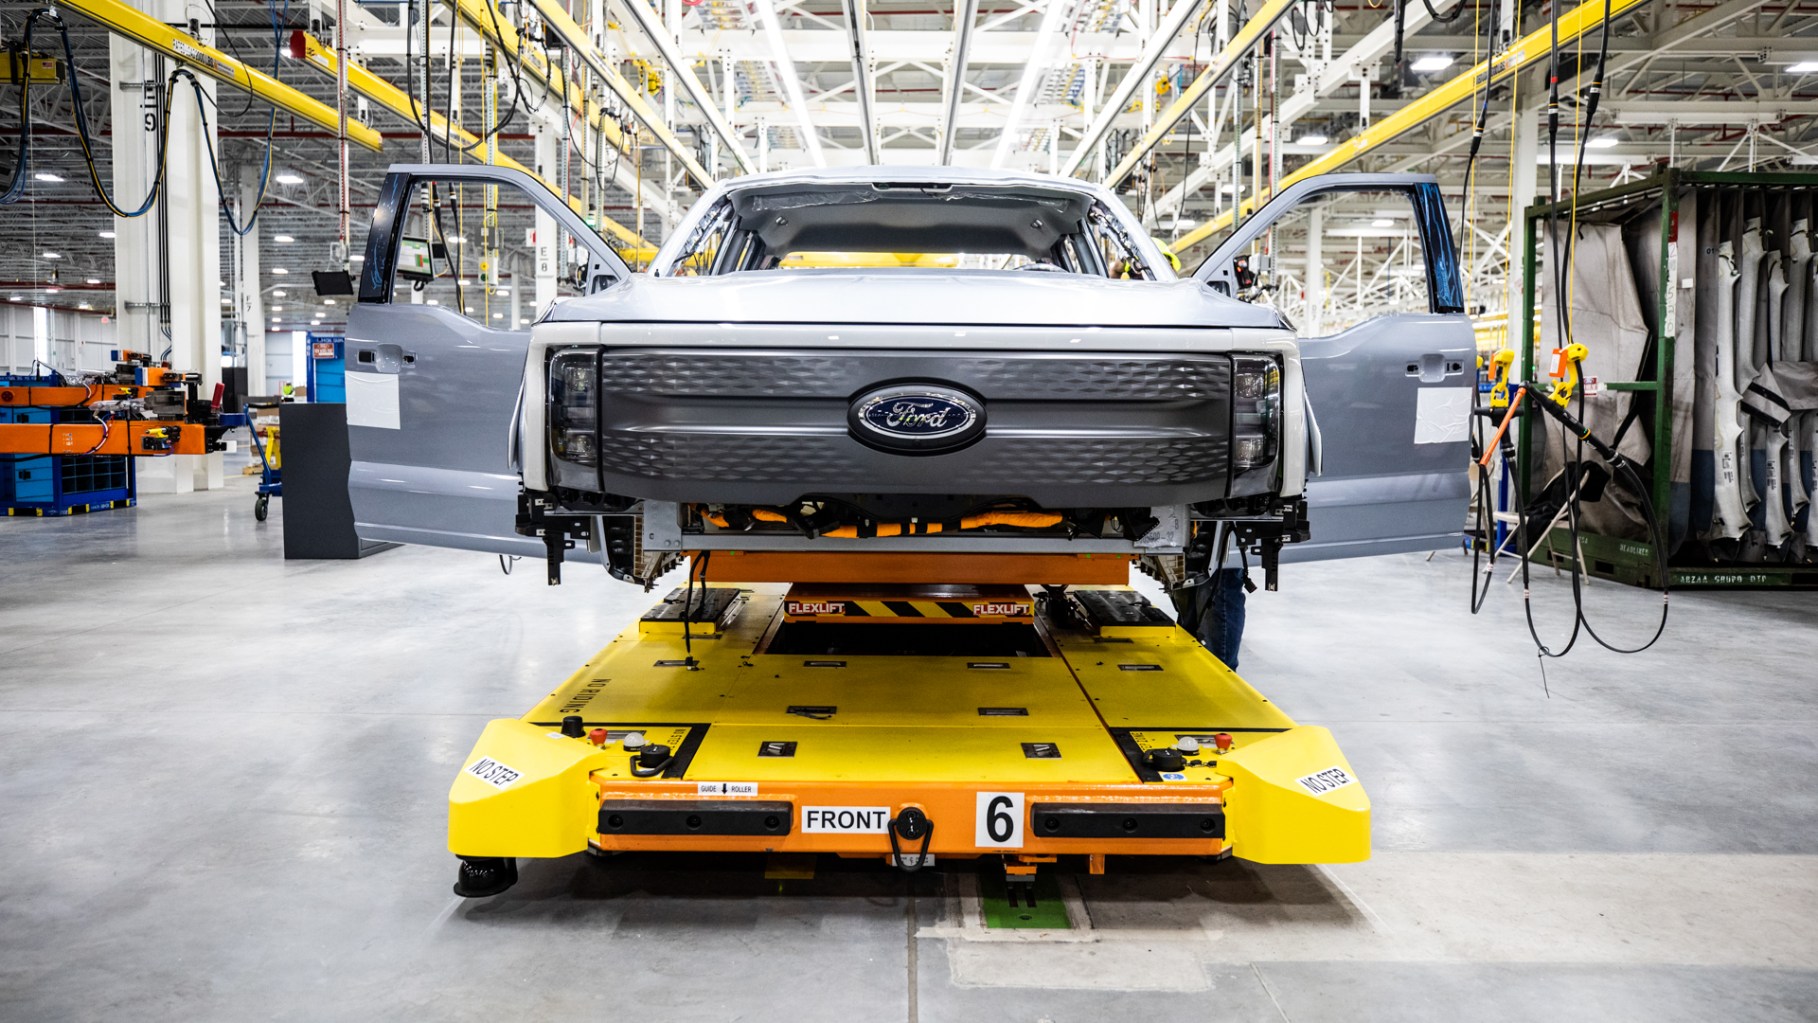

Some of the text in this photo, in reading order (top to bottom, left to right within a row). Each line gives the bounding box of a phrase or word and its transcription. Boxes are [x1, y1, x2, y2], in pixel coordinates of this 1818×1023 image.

[541, 247, 547, 256] E
[541, 262, 548, 272] 8
[886, 401, 951, 427] Ford
[788, 603, 845, 614] FLEXLIFT
[973, 604, 1029, 615] FLEXLIFT
[560, 679, 612, 713] NO RIDING
[469, 758, 519, 785] NO STEP
[1300, 768, 1350, 793] NO STEP
[807, 811, 886, 829] FRONT
[986, 795, 1014, 843] 6
